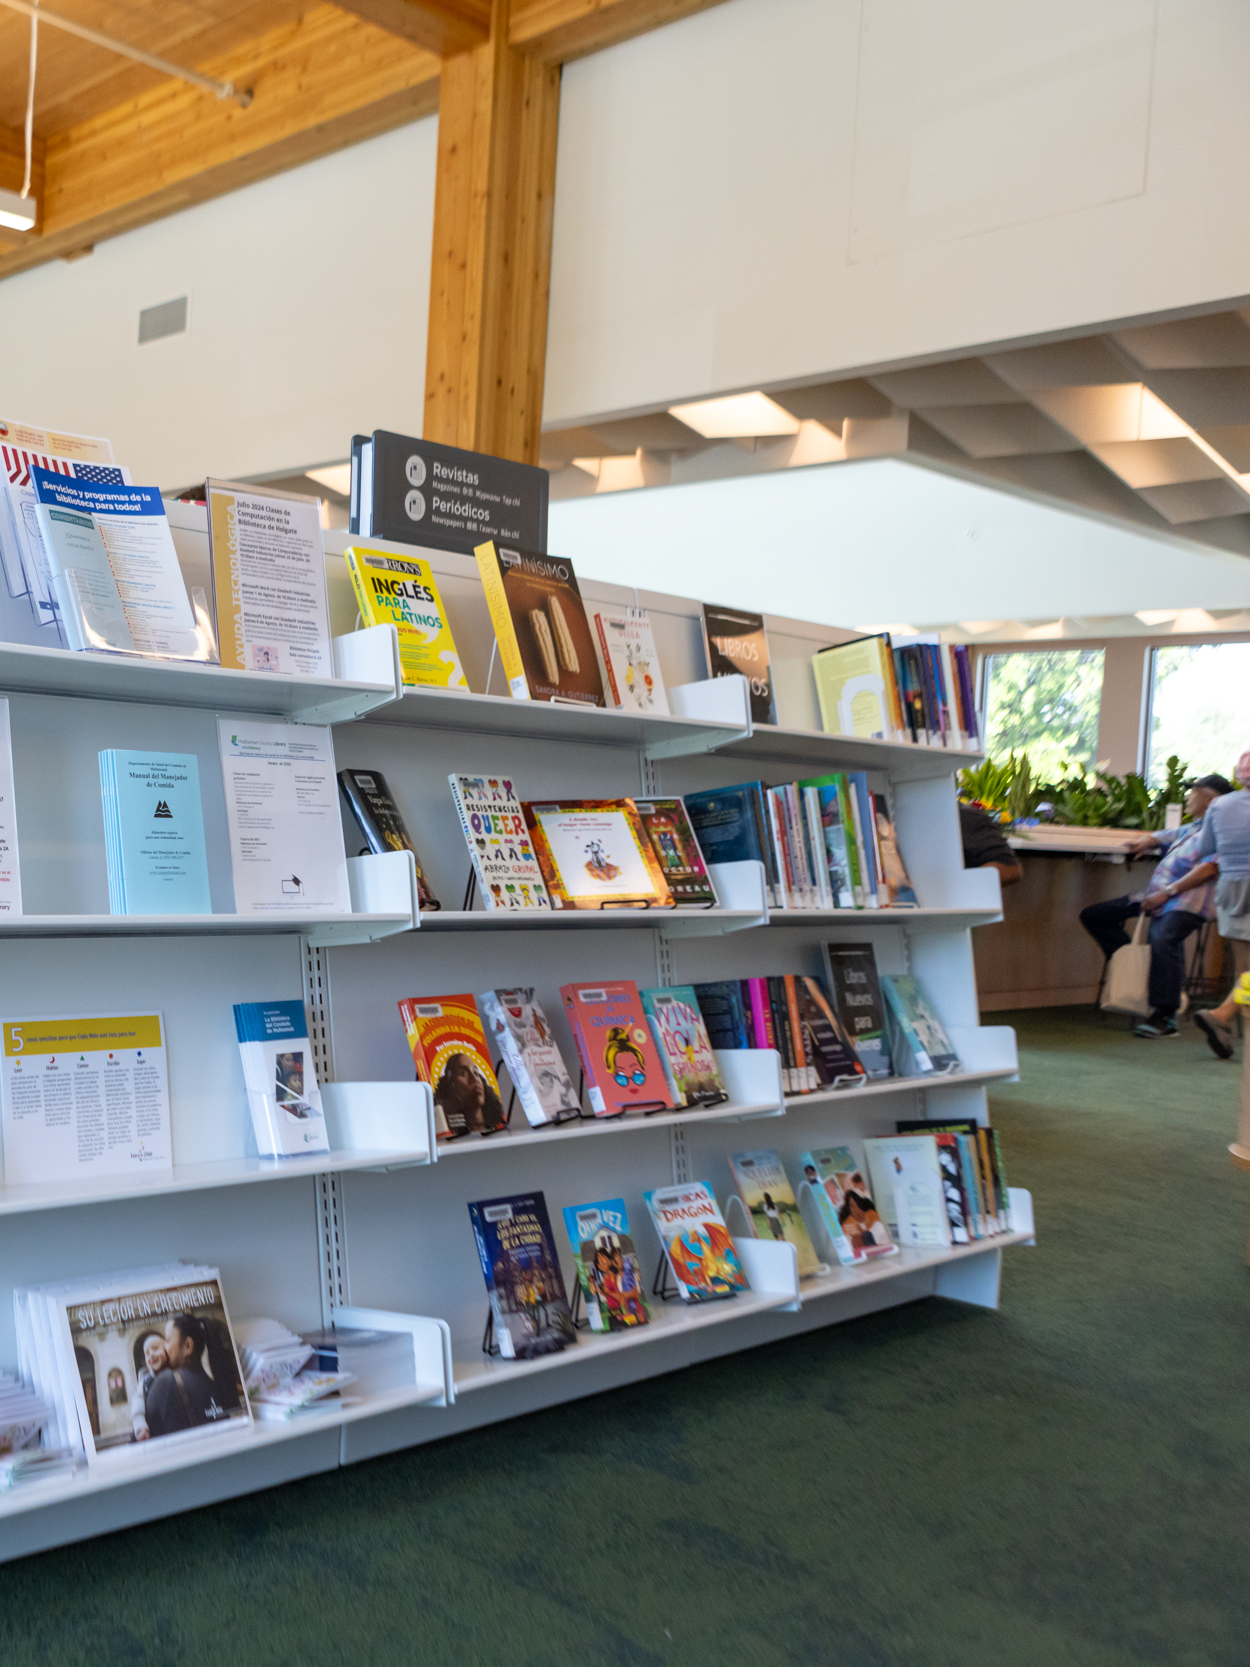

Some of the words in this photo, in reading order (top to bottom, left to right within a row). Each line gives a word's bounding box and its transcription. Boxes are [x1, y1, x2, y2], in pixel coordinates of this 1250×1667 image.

[433, 462, 479, 485] Revistas
[42, 481, 78, 496] ¡Servicios
[78, 489, 84, 498] y
[84, 491, 129, 502] programas
[130, 493, 141, 501] de
[142, 493, 151, 501] la
[432, 481, 460, 494] Magazines
[55, 493, 94, 508] biblioteca
[95, 501, 113, 510] para
[115, 502, 141, 511] todos!
[251, 503, 264, 511] 2024
[265, 506, 282, 515] Clases
[432, 496, 490, 521] Periódicos
[238, 510, 275, 522] Computación
[432, 515, 464, 528] Newspapers
[238, 519, 266, 529] Biblioteca
[276, 525, 297, 535] Holgate
[227, 505, 242, 609] TECNOLÓGICA
[371, 577, 434, 603] INGLÉS
[376, 595, 411, 611] PARA
[391, 609, 443, 629] LATINOS
[233, 613, 246, 670] AYUDA
[716, 636, 759, 662] LIBROS
[439, 650, 464, 687] 2
[535, 686, 559, 696] SANDRA
[568, 691, 599, 702] GUTIERREZ
[451, 783, 466, 824] RESISTENCIAS
[466, 804, 520, 813] RESISTENCIAS
[470, 813, 526, 836] QUEER
[484, 864, 510, 873] ABRAZO
[512, 865, 538, 873] GRUPAL
[844, 968, 867, 984] Libros
[845, 991, 873, 1006] Nuevos
[590, 1012, 636, 1028] QUÍMICA
[854, 1016, 873, 1031] para
[11, 1027, 24, 1052] 5
[663, 1029, 711, 1057] LOLA
[78, 1308, 96, 1330] SU
[98, 1299, 137, 1326] LECTOR
[139, 1300, 152, 1317] EN
[154, 1286, 215, 1314] CRECIMIENTO
